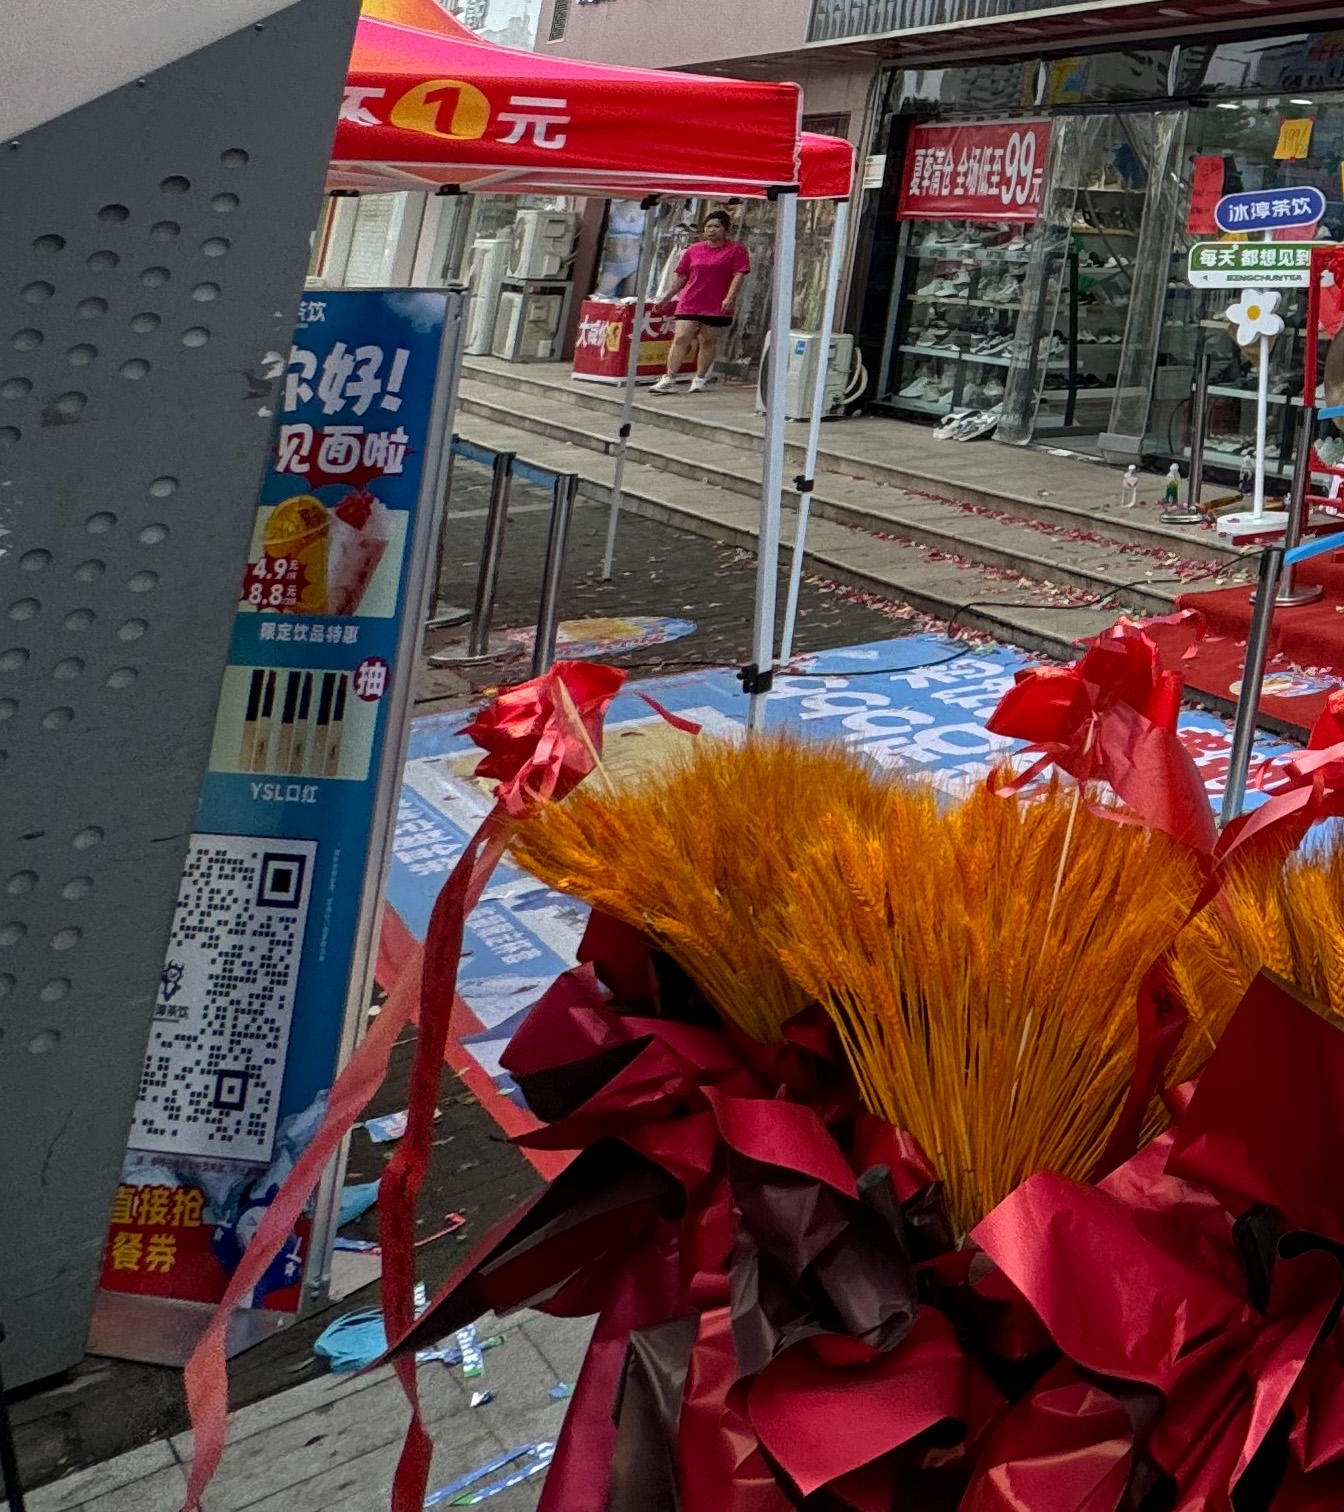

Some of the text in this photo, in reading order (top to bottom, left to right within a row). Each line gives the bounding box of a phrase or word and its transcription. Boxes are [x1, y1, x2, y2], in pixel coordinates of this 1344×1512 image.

[1228, 197, 1312, 223] 冰淳茶饮
[1200, 249, 1235, 267] 每天
[274, 426, 408, 475] 见面啦
[260, 622, 360, 645] 限定饮品特惠
[357, 660, 387, 698] 抽
[250, 782, 318, 805] YSL口红
